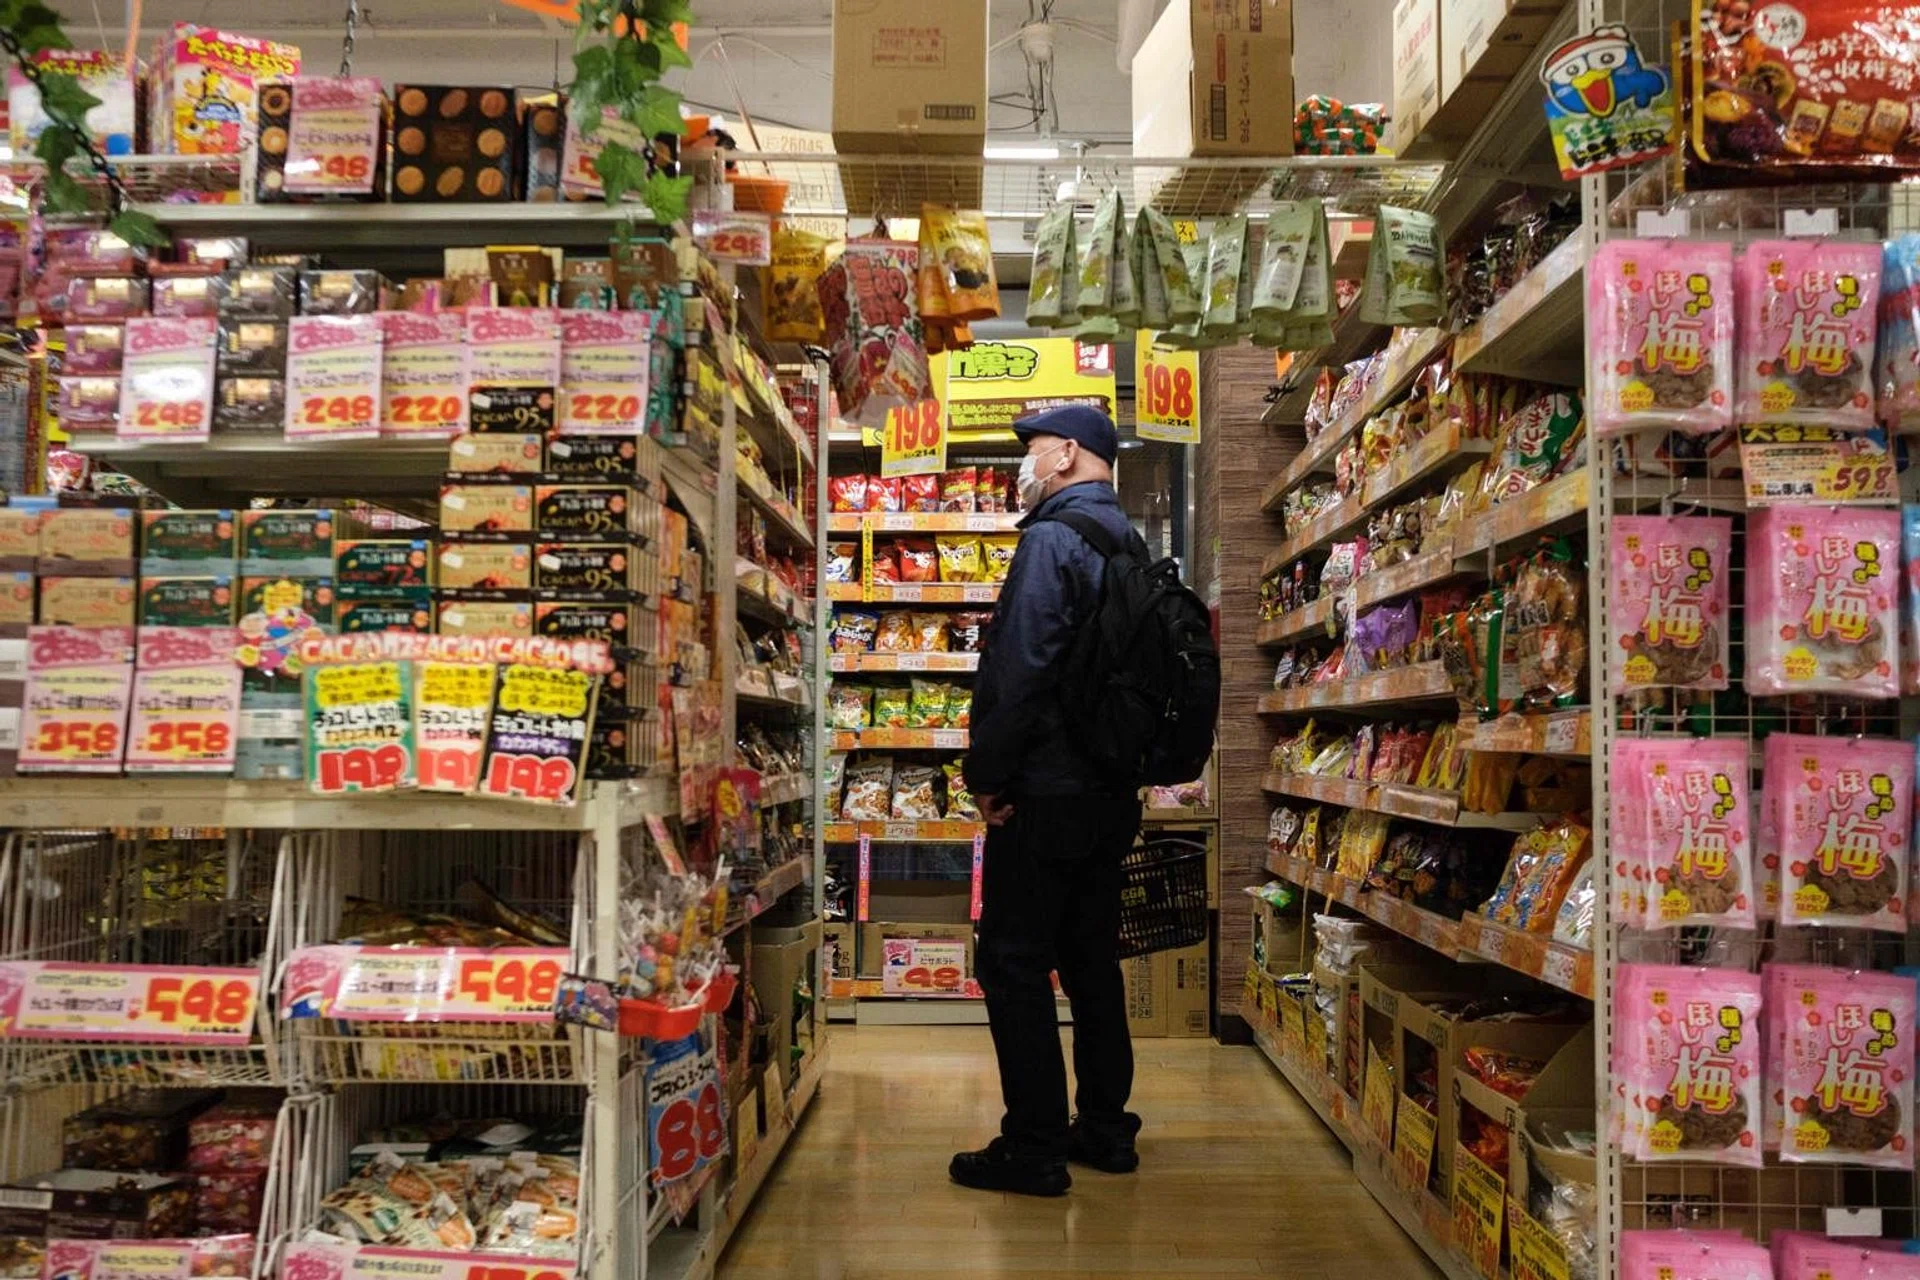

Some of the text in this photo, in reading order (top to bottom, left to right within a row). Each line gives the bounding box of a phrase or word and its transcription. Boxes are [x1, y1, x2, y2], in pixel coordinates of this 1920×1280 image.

[951, 343, 1036, 378] 菓子
[1144, 362, 1194, 418] 198
[137, 400, 205, 426] 298
[303, 395, 374, 423] 298
[390, 395, 461, 423] 220
[571, 394, 641, 420] 220
[892, 399, 941, 452] 198
[1833, 466, 1893, 492] 598
[37, 721, 118, 752] 358
[148, 721, 229, 752] 358
[417, 748, 481, 791] 19
[460, 960, 562, 1003] 598
[904, 967, 960, 988] 98
[146, 977, 253, 1024] 598
[656, 1081, 724, 1181] 88
